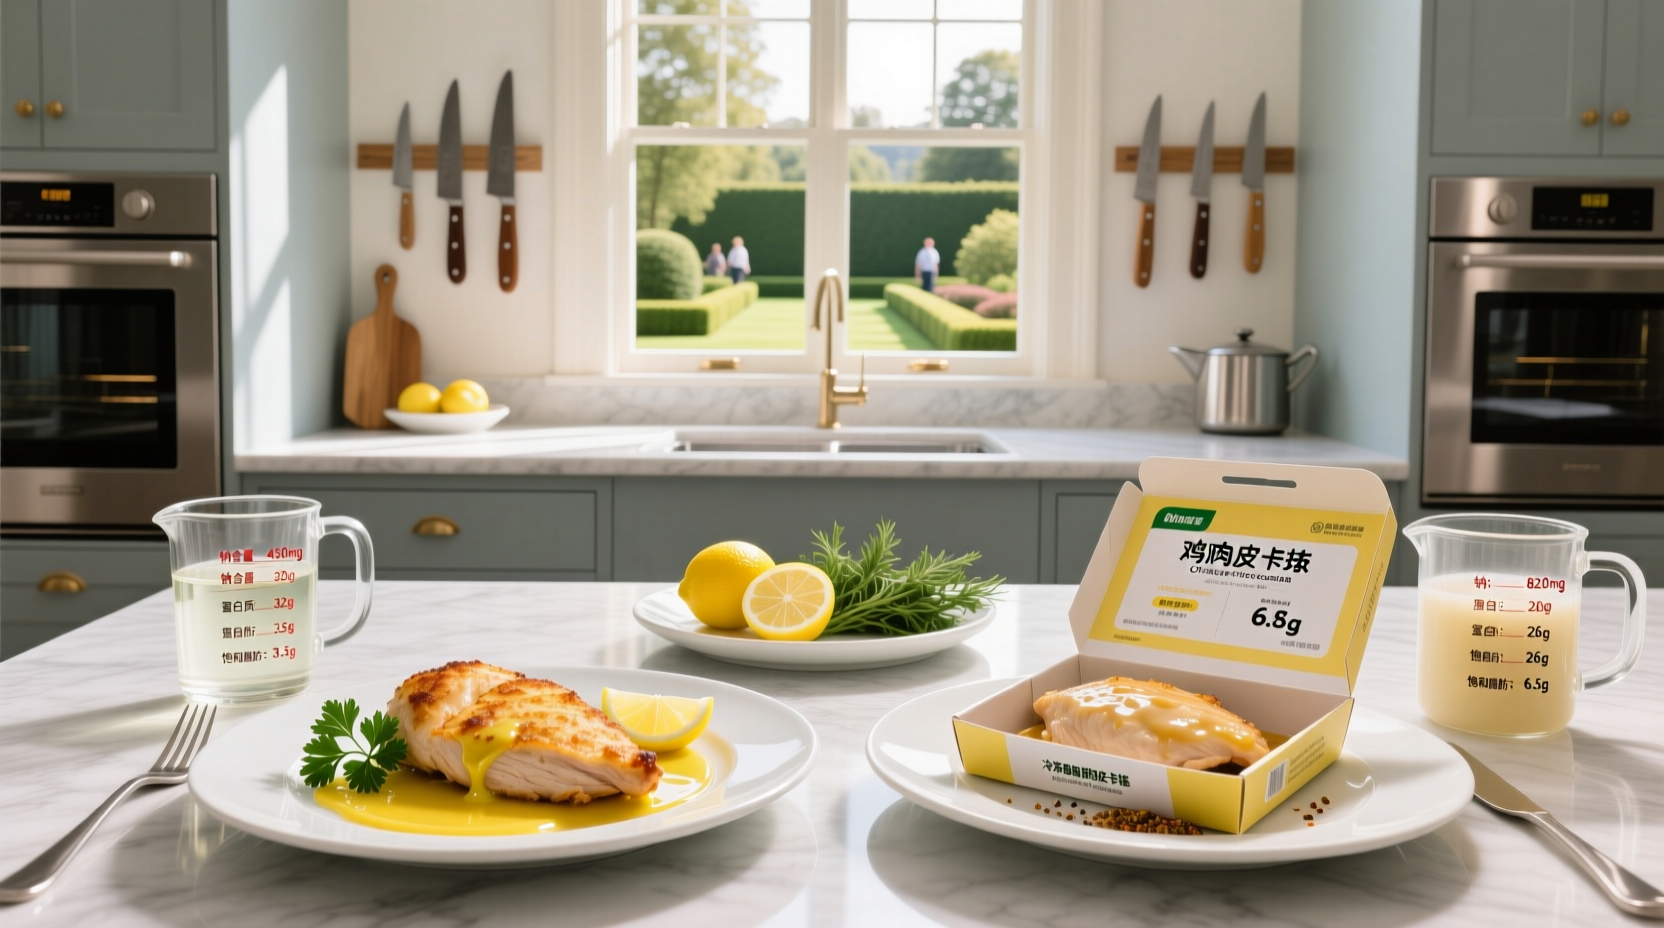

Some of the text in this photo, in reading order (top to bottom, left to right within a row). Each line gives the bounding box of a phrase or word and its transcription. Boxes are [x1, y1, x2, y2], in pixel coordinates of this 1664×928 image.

[266, 547, 303, 562] 450mg
[1526, 576, 1566, 593] 820mg
[273, 597, 294, 610] 32g
[1527, 600, 1552, 615] 20g
[1251, 606, 1303, 637] 6.8g
[1526, 625, 1550, 642] 26g
[272, 645, 296, 660] 3.5g
[1525, 651, 1549, 667] 26g
[1523, 677, 1549, 694] 6.5g
